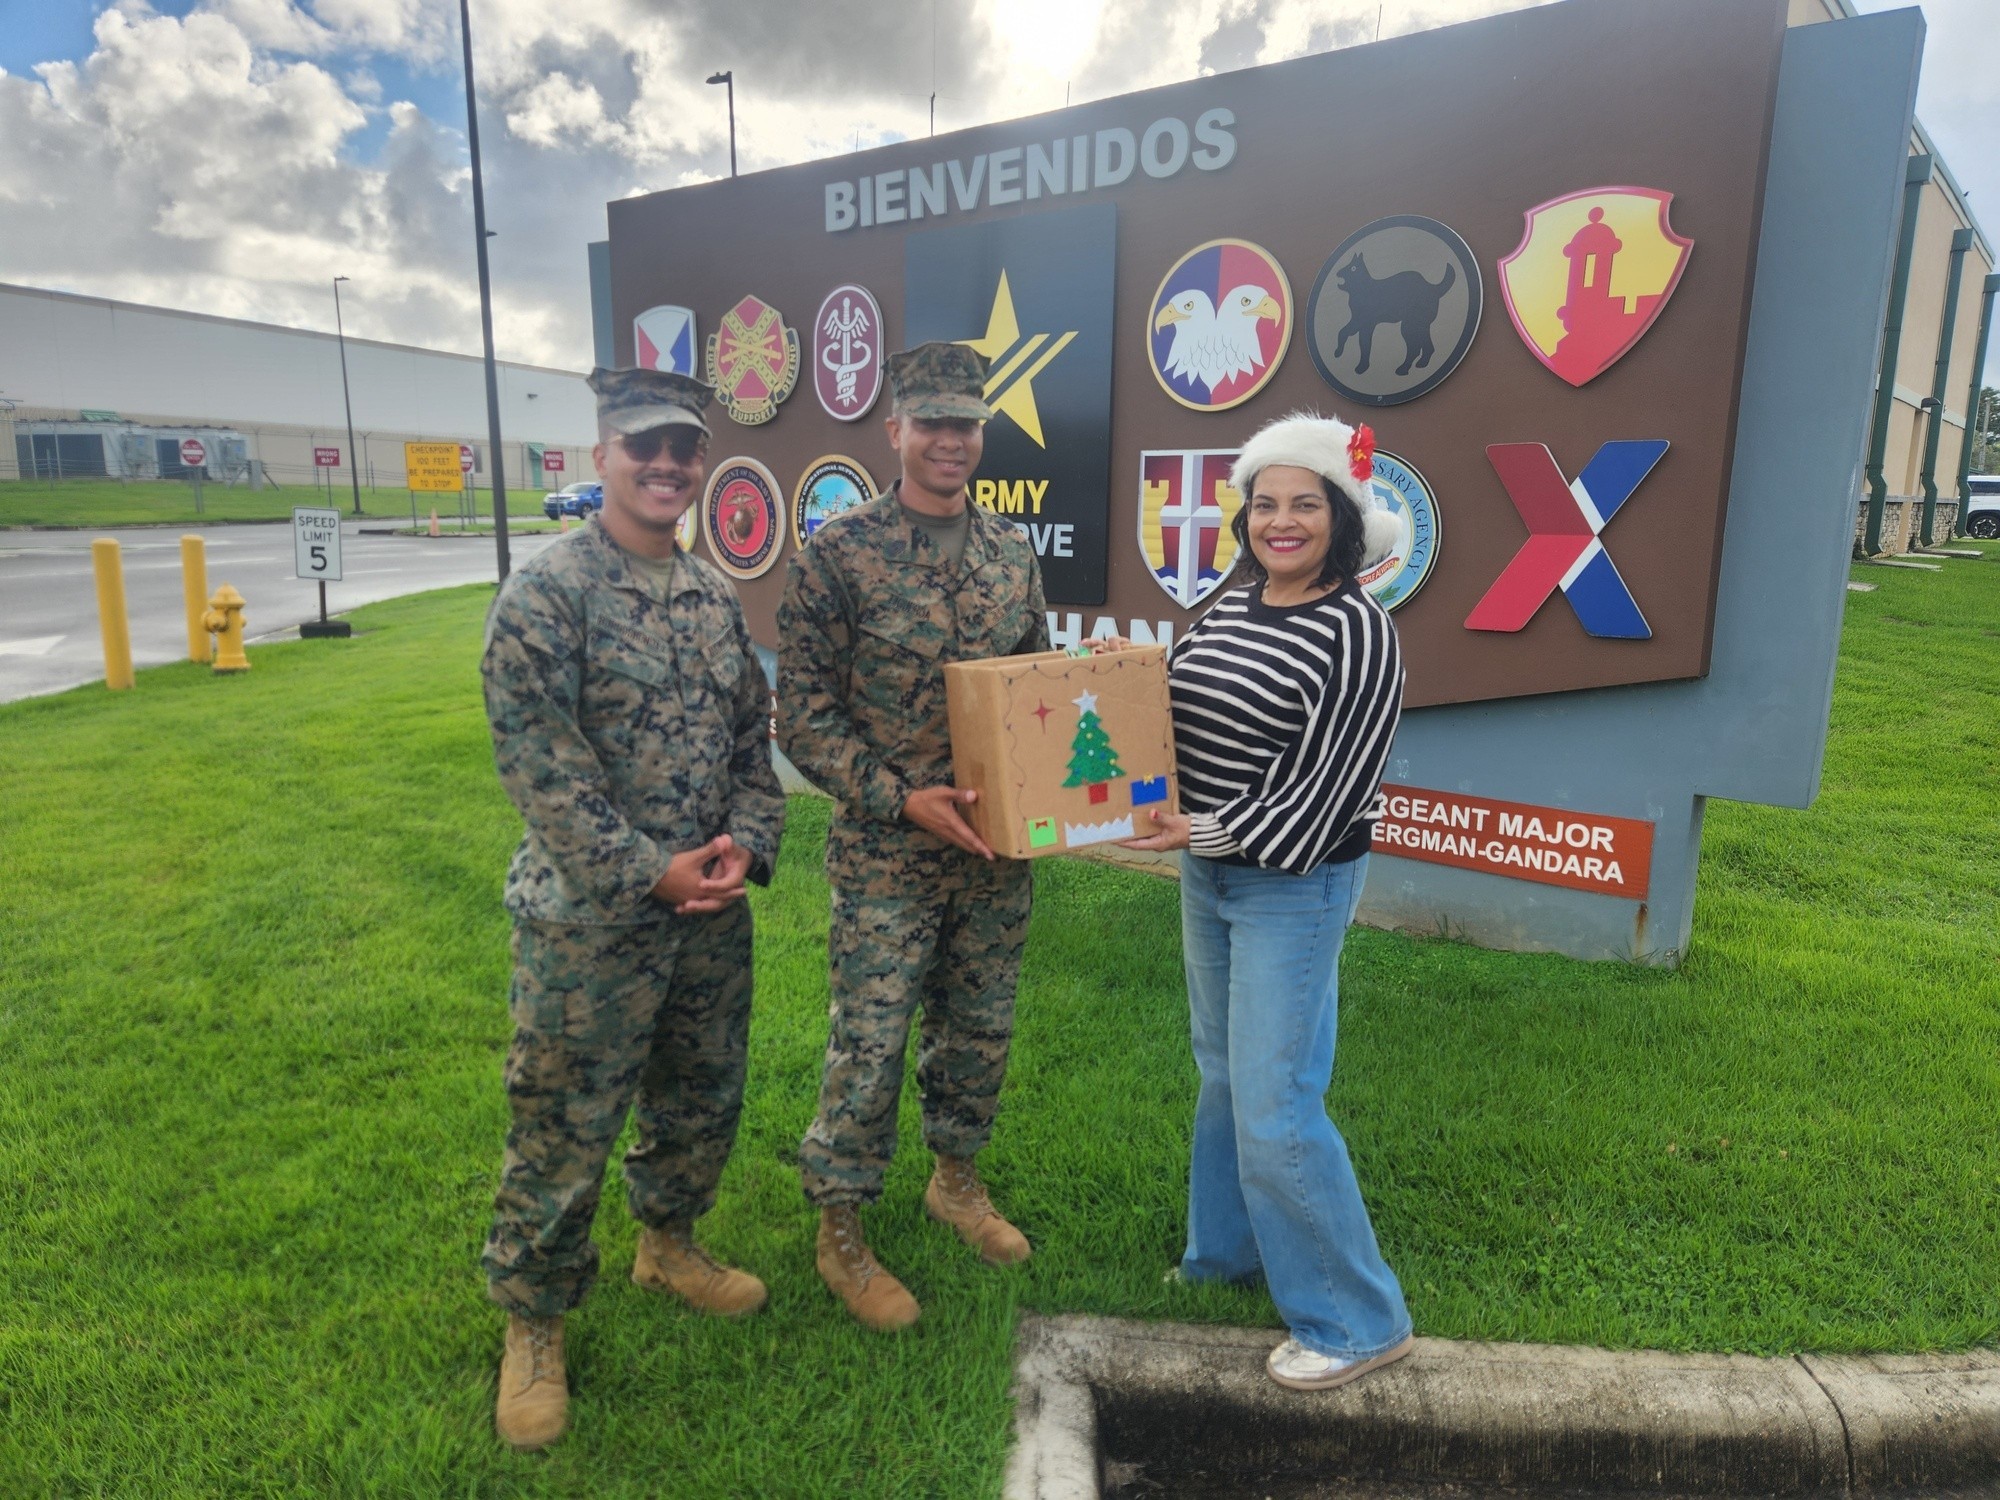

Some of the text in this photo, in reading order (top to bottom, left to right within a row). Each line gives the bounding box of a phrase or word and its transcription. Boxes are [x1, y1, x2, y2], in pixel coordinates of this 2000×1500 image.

[825, 107, 1238, 232] BIENVENIDOS
[782, 344, 797, 393] DEFEND
[733, 409, 771, 422] SUPPORT
[411, 446, 454, 454] CHECKPOINT
[433, 457, 450, 465] FEET
[408, 468, 461, 477] BE PREPARED
[838, 464, 864, 486] SUPPORT
[433, 480, 452, 488] STOP
[298, 516, 336, 528] SPEED
[303, 530, 333, 542] LIMIT
[1407, 497, 1429, 576] AGENCY
[310, 546, 327, 571] 5
[1358, 560, 1394, 585] EOPLE ALWAYS
[1379, 792, 1614, 852] RGEANT MAJOR
[1371, 821, 1624, 884] ERGMAN-GANDARA
